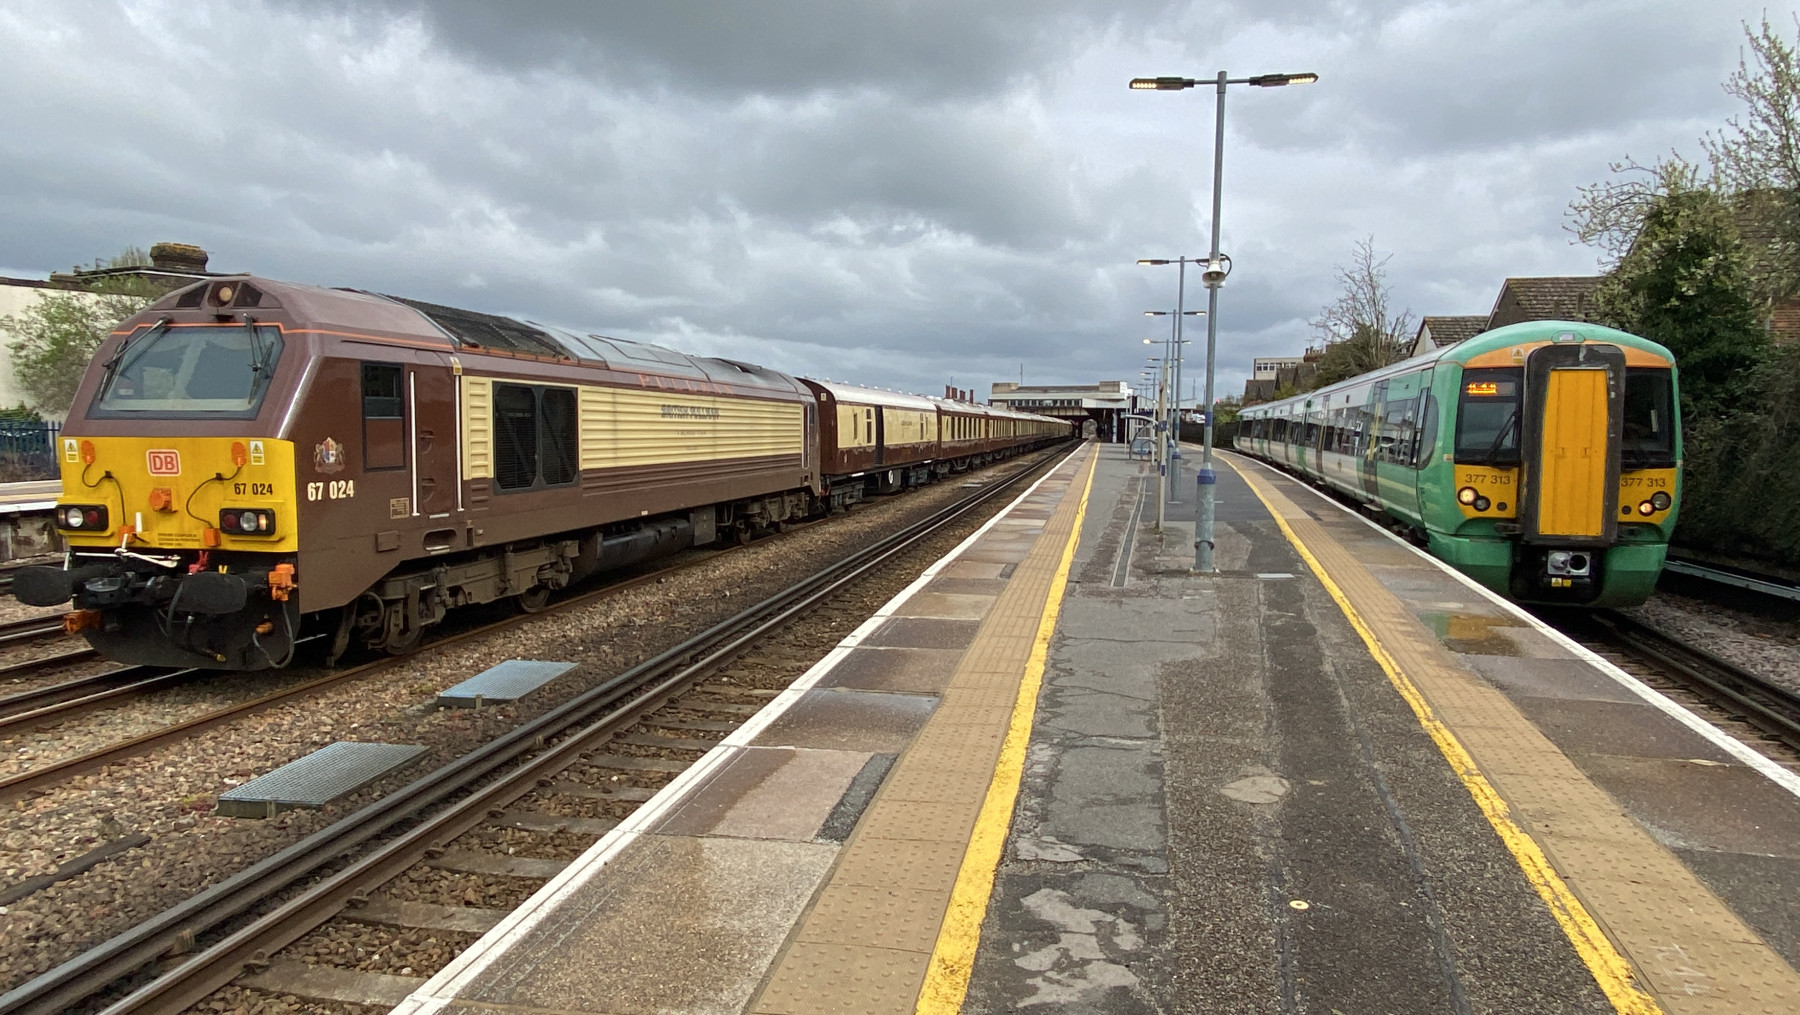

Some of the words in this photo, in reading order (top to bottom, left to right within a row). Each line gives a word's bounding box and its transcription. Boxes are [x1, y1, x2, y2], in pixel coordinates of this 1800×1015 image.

[153, 455, 175, 471] DB
[1465, 474, 1486, 484] 377
[1490, 474, 1511, 485] 313
[1621, 477, 1643, 487] 377
[1647, 477, 1666, 488] 313
[234, 482, 247, 495] 67
[252, 482, 273, 495] 024
[307, 482, 324, 501] 67
[329, 479, 355, 500] 024
